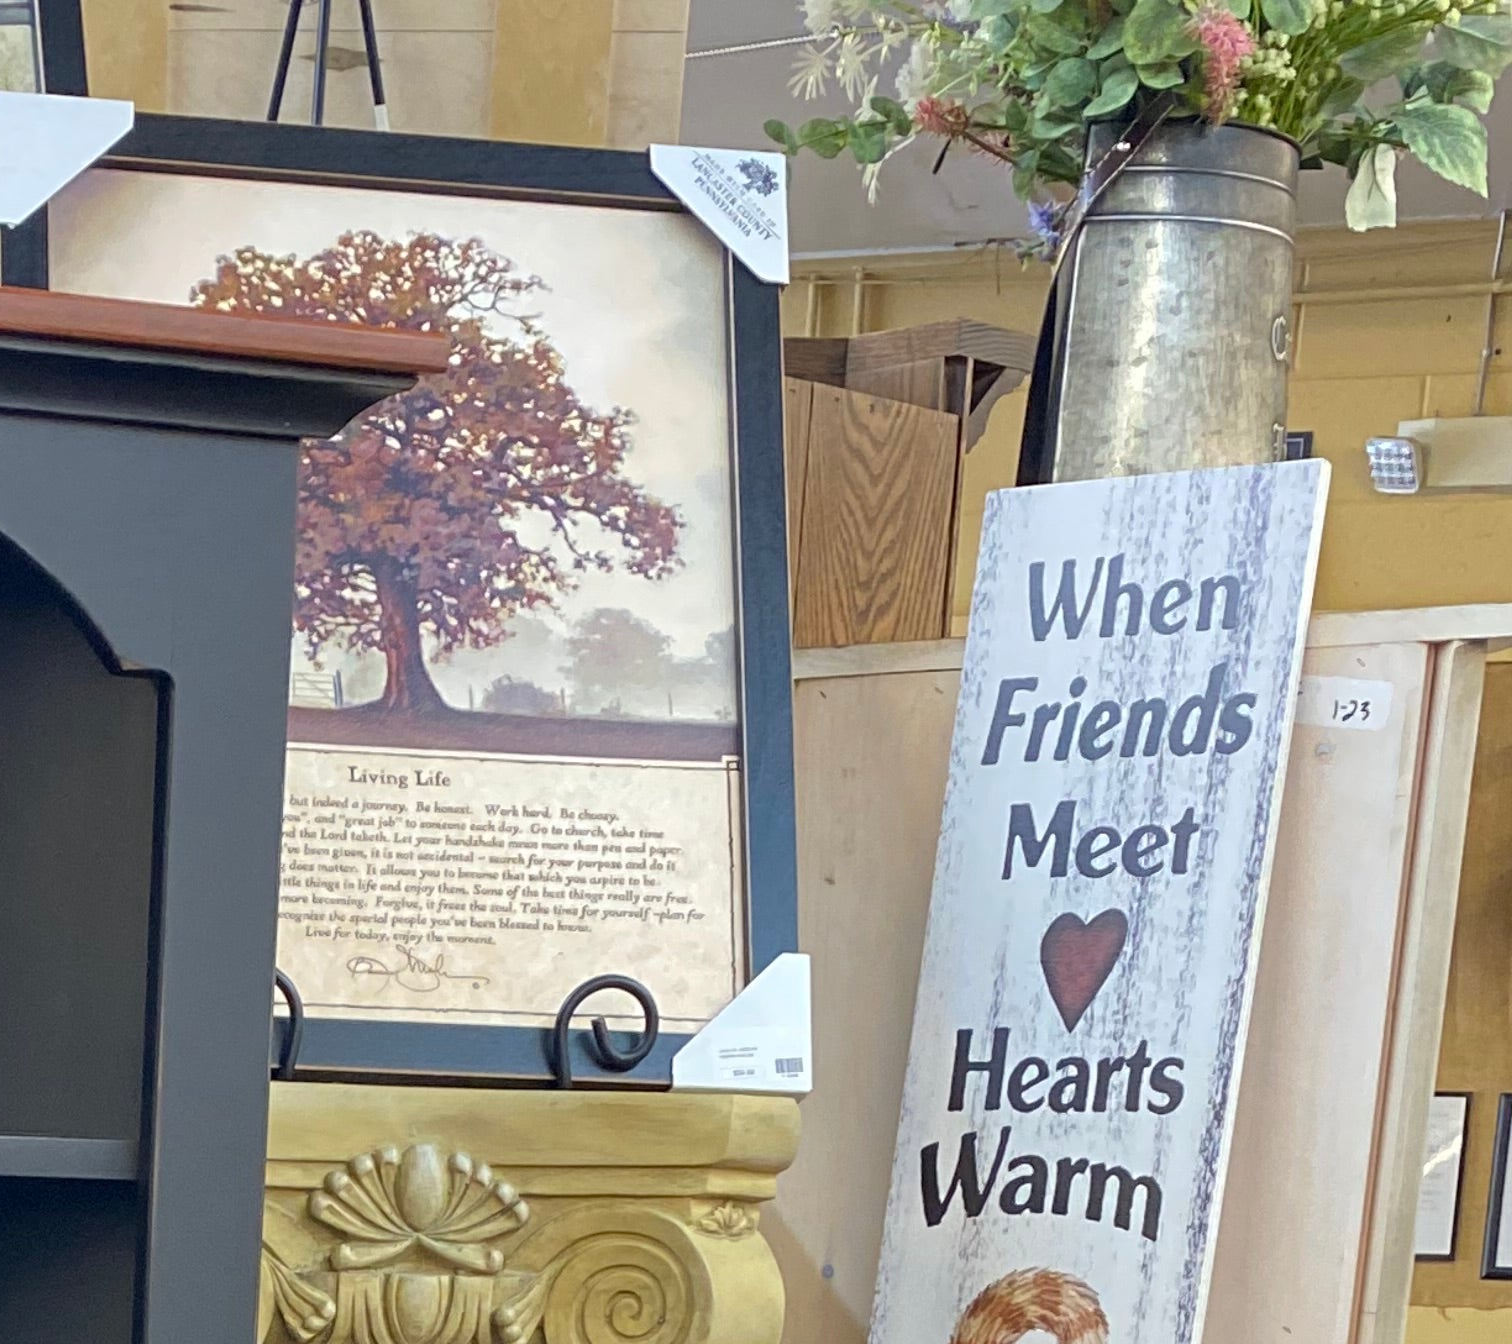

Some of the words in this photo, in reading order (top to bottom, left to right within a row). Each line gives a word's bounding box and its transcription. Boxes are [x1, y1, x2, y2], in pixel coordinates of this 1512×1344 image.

[736, 204, 773, 241] COUNTY
[1028, 552, 1241, 642] When
[980, 660, 1258, 766] Friends
[348, 765, 408, 789] Living
[414, 769, 451, 787] Life
[289, 795, 308, 807] but
[312, 796, 349, 809] indeed
[352, 801, 359, 809] a
[416, 801, 430, 813] Be
[484, 804, 518, 817] Work
[560, 807, 576, 819] Be
[314, 812, 336, 824] and
[405, 816, 417, 828] to
[470, 819, 495, 832] each
[530, 822, 548, 834] Go
[551, 823, 562, 835] to
[610, 826, 635, 838] take
[1001, 799, 1200, 881] Meet
[299, 827, 316, 839] the
[320, 828, 347, 841] Lord
[394, 832, 412, 844] Let
[416, 836, 442, 848] your
[541, 842, 569, 851] more
[573, 840, 598, 852] than
[602, 845, 622, 857] pen
[625, 842, 646, 855] and
[304, 843, 330, 856] been
[382, 847, 394, 859] is
[396, 848, 414, 860] not
[416, 849, 474, 863] accidental
[488, 852, 524, 865] search
[526, 854, 546, 869] for
[548, 858, 574, 870] your
[577, 860, 622, 873] purpose
[624, 858, 646, 871] and
[649, 859, 663, 871] do
[289, 859, 314, 871] does
[366, 862, 376, 874] It
[380, 863, 416, 876] allows
[419, 869, 440, 880] you
[444, 866, 455, 878] to
[502, 869, 525, 881] that
[528, 870, 562, 883] which
[565, 875, 586, 887] you
[589, 873, 625, 889] aspire
[628, 875, 640, 886] to
[305, 876, 339, 892] things
[343, 877, 354, 889] in
[358, 878, 378, 893] life
[380, 879, 401, 891] and
[404, 880, 434, 896] enjoy
[438, 882, 470, 894] them.
[473, 883, 503, 896] Some
[506, 885, 520, 900] of
[522, 886, 538, 898] the
[542, 887, 565, 899] best
[568, 888, 604, 904] things
[607, 890, 640, 906] really
[643, 895, 662, 903] are
[280, 894, 309, 903] more
[438, 898, 466, 914] frees
[470, 899, 486, 912] the
[520, 902, 549, 914] Take
[579, 905, 598, 920] for
[602, 906, 651, 922] yourself
[687, 910, 705, 925] for
[329, 909, 345, 921] the
[349, 910, 388, 927] special
[391, 912, 427, 928] people
[470, 916, 496, 928] been
[499, 917, 539, 930] blessed
[542, 919, 554, 931] to
[305, 925, 330, 937] Live
[333, 926, 351, 941] for
[392, 929, 424, 945] enjoy
[426, 930, 444, 942] the
[947, 1026, 1186, 1115] Hearts
[919, 1125, 1164, 1242] Warm
